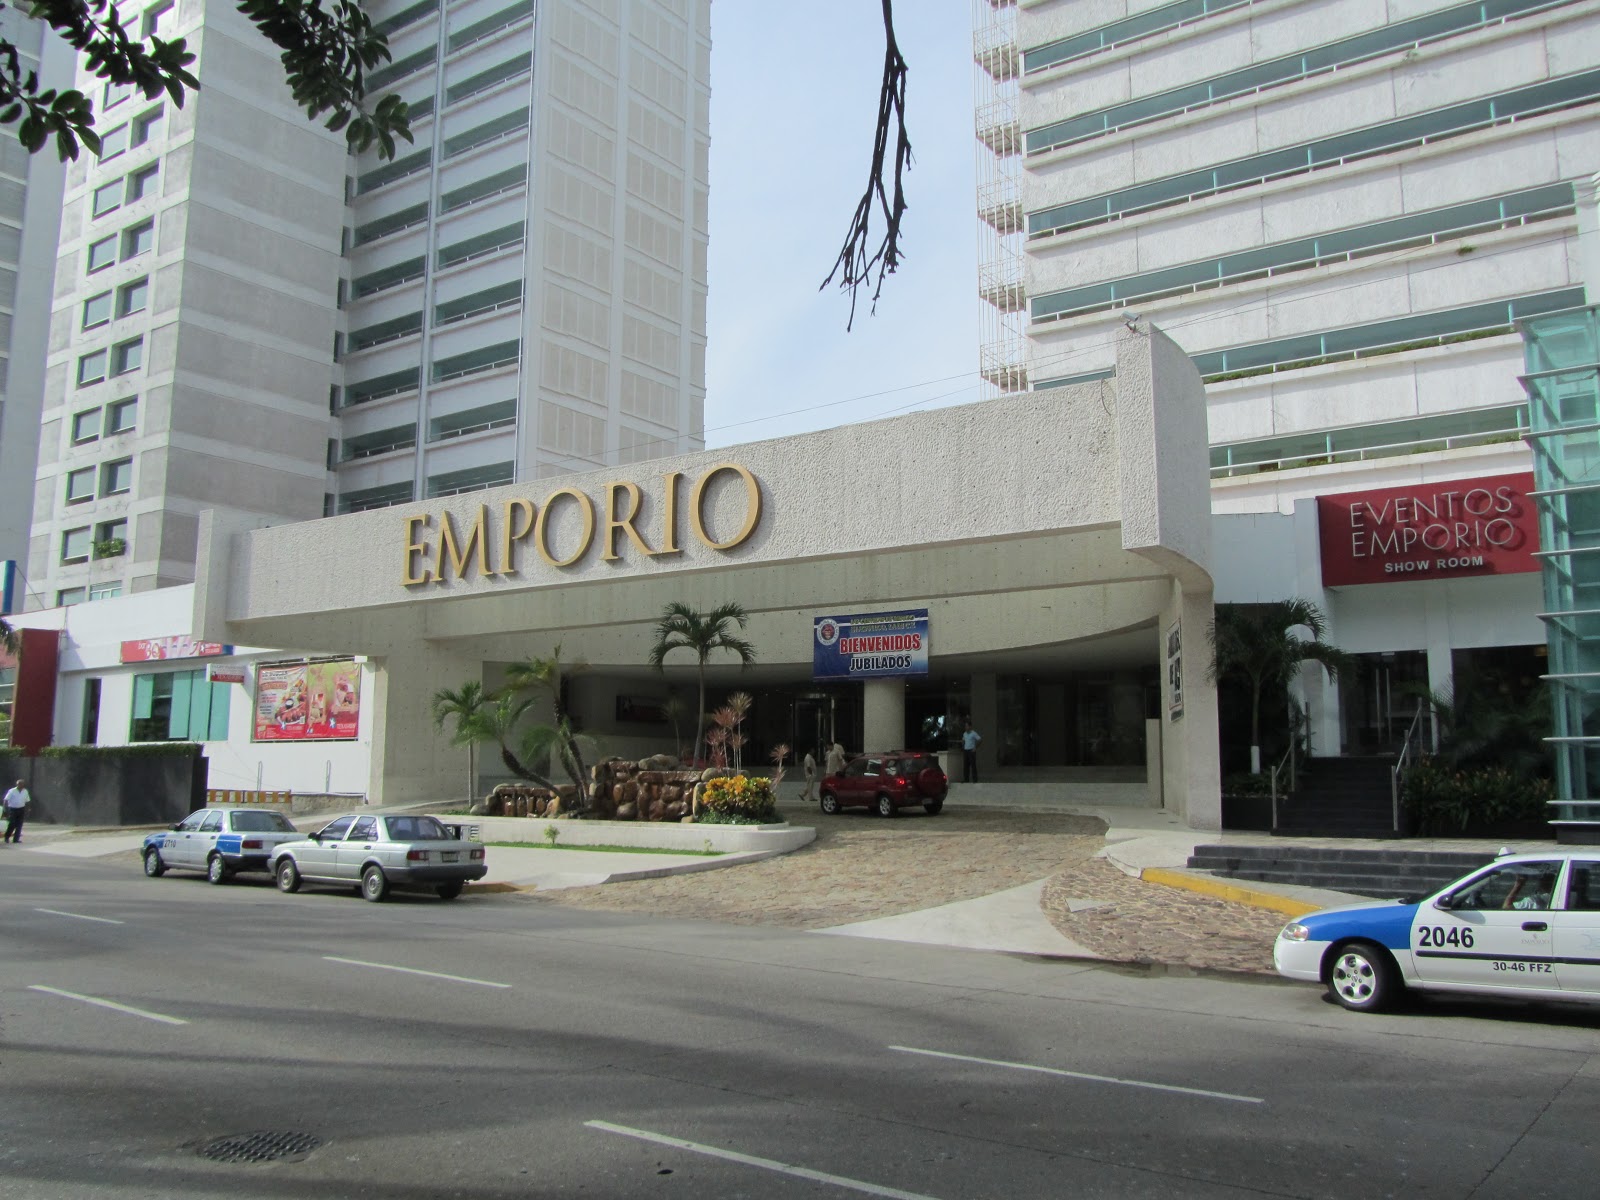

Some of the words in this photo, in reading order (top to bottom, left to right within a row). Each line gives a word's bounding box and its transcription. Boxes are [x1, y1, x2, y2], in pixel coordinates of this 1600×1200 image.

[1350, 486, 1513, 528] EVENTOS
[399, 462, 763, 586] EMPORIO
[1352, 518, 1515, 558] EMPORIO
[1384, 559, 1430, 573] SHOW
[1436, 555, 1484, 569] ROOM
[840, 634, 920, 654] BIENVENIDOS
[850, 655, 911, 671] JUBILADOS
[1418, 926, 1474, 948] 2046
[1492, 961, 1526, 972] 30-46
[1529, 963, 1553, 973] FFZ
